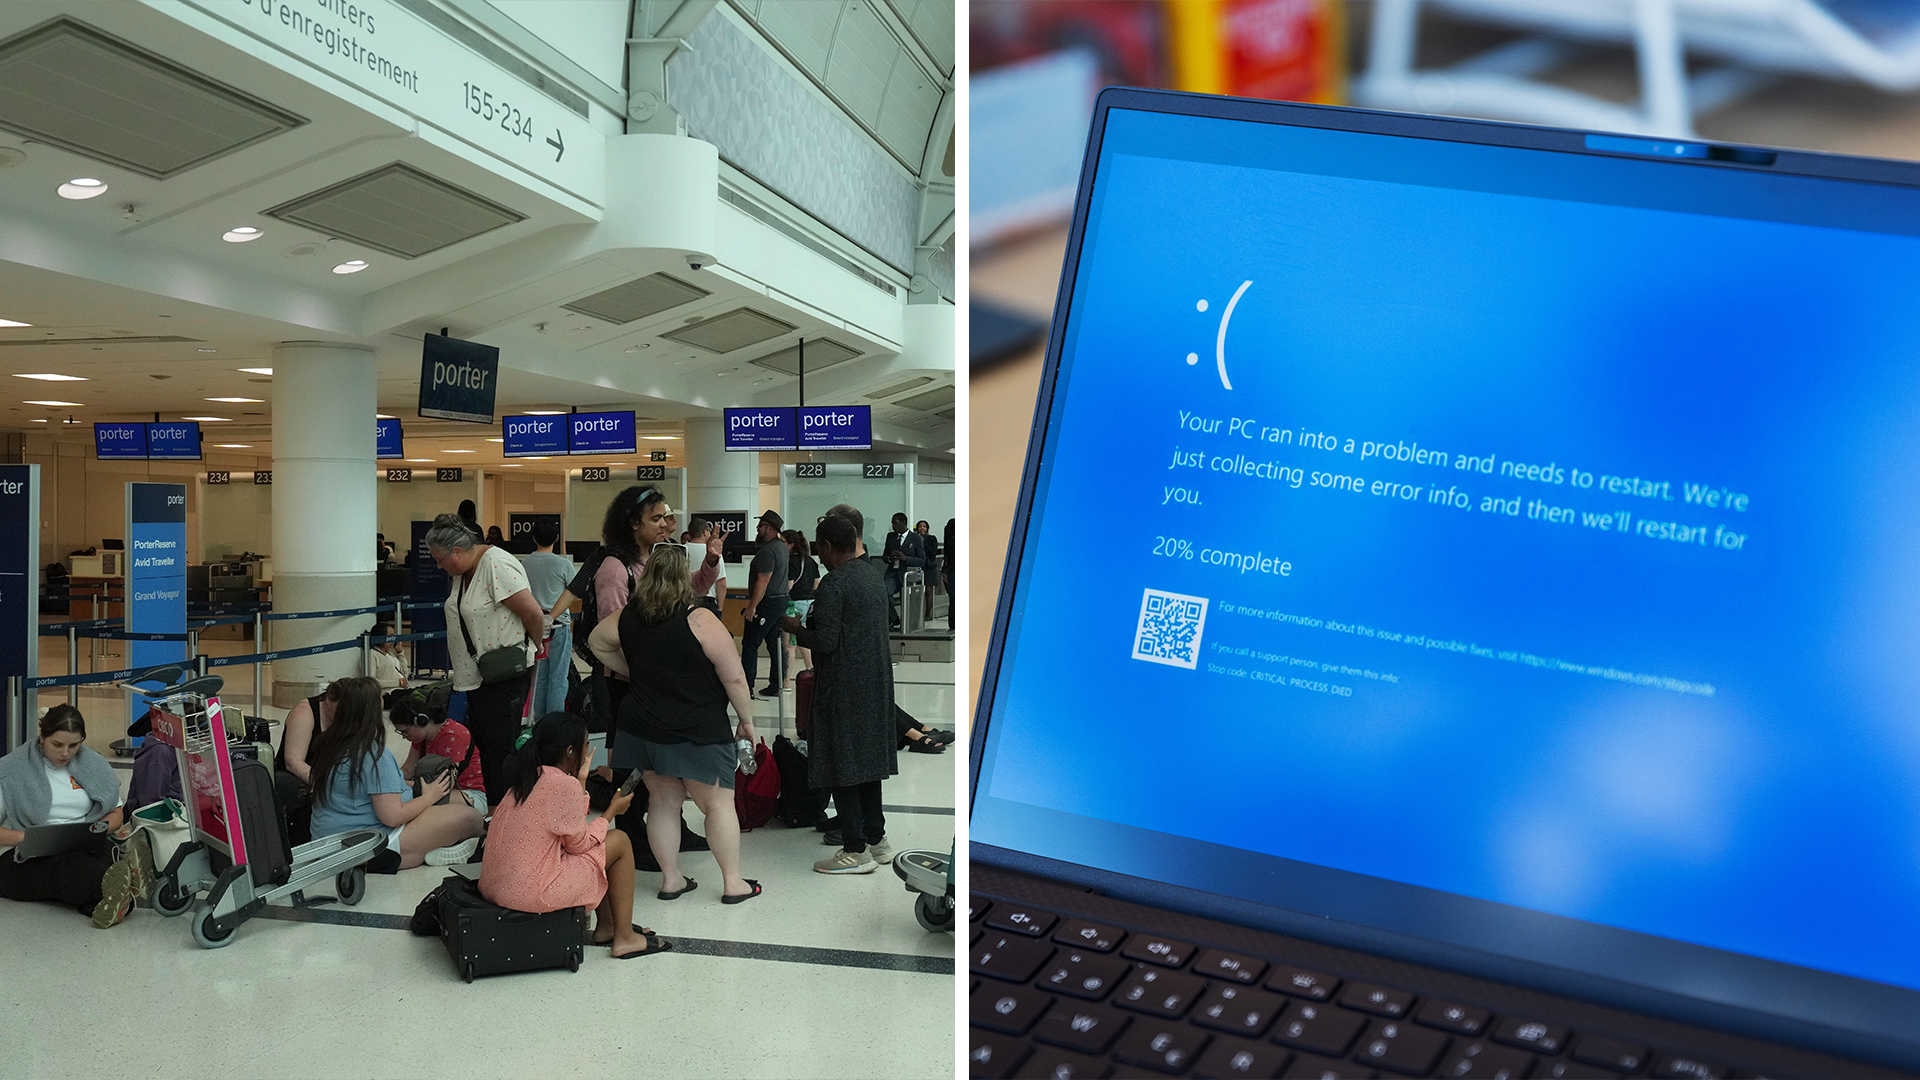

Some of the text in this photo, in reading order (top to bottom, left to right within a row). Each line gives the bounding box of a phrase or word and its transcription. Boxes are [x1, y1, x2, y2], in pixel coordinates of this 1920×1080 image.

[260, 0, 418, 93] denregistrement
[463, 81, 533, 143] 155-234
[432, 361, 489, 391] porter
[574, 417, 620, 435] porter
[731, 412, 780, 431] porter
[803, 411, 855, 430] porter
[99, 427, 134, 442] porter
[150, 427, 187, 442] porter
[508, 420, 553, 438] porter
[1179, 410, 1750, 513] Your PC ran into a problem and needs to restart. We're
[209, 472, 228, 483] 234
[389, 470, 408, 481] 232
[441, 470, 458, 481] 231
[584, 469, 606, 481] 230
[640, 467, 661, 479] 229
[799, 464, 823, 477] 228
[866, 464, 890, 477] 227
[167, 494, 185, 507] porter
[1161, 486, 1202, 505] you.
[1168, 446, 1749, 551] just collecting some error info, and then we'll restart for
[706, 518, 743, 533] orter
[134, 540, 176, 550] PorterReserve
[134, 558, 151, 568] Avid
[1152, 536, 1292, 577] 20% complete
[134, 591, 156, 601] Grand
[1219, 600, 1236, 614] For
[1237, 604, 1265, 618] more
[1266, 608, 1323, 629] information
[1325, 620, 1356, 635] about
[1357, 625, 1375, 639] this
[1377, 628, 1402, 643] issue
[1403, 635, 1426, 647] and
[1425, 638, 1468, 654] possible
[214, 657, 228, 665] porter
[265, 652, 279, 660] porter
[1211, 642, 1219, 651] If
[1218, 645, 1234, 655] you
[1234, 647, 1250, 657] call
[1250, 650, 1256, 659] a
[1257, 651, 1289, 664] support
[1289, 656, 1319, 671] person,
[1321, 661, 1340, 674] give
[1340, 664, 1363, 677] them
[1363, 669, 1379, 681] this
[113, 670, 132, 679] porter
[1207, 662, 1226, 676] Stop
[36, 678, 57, 687] porter
